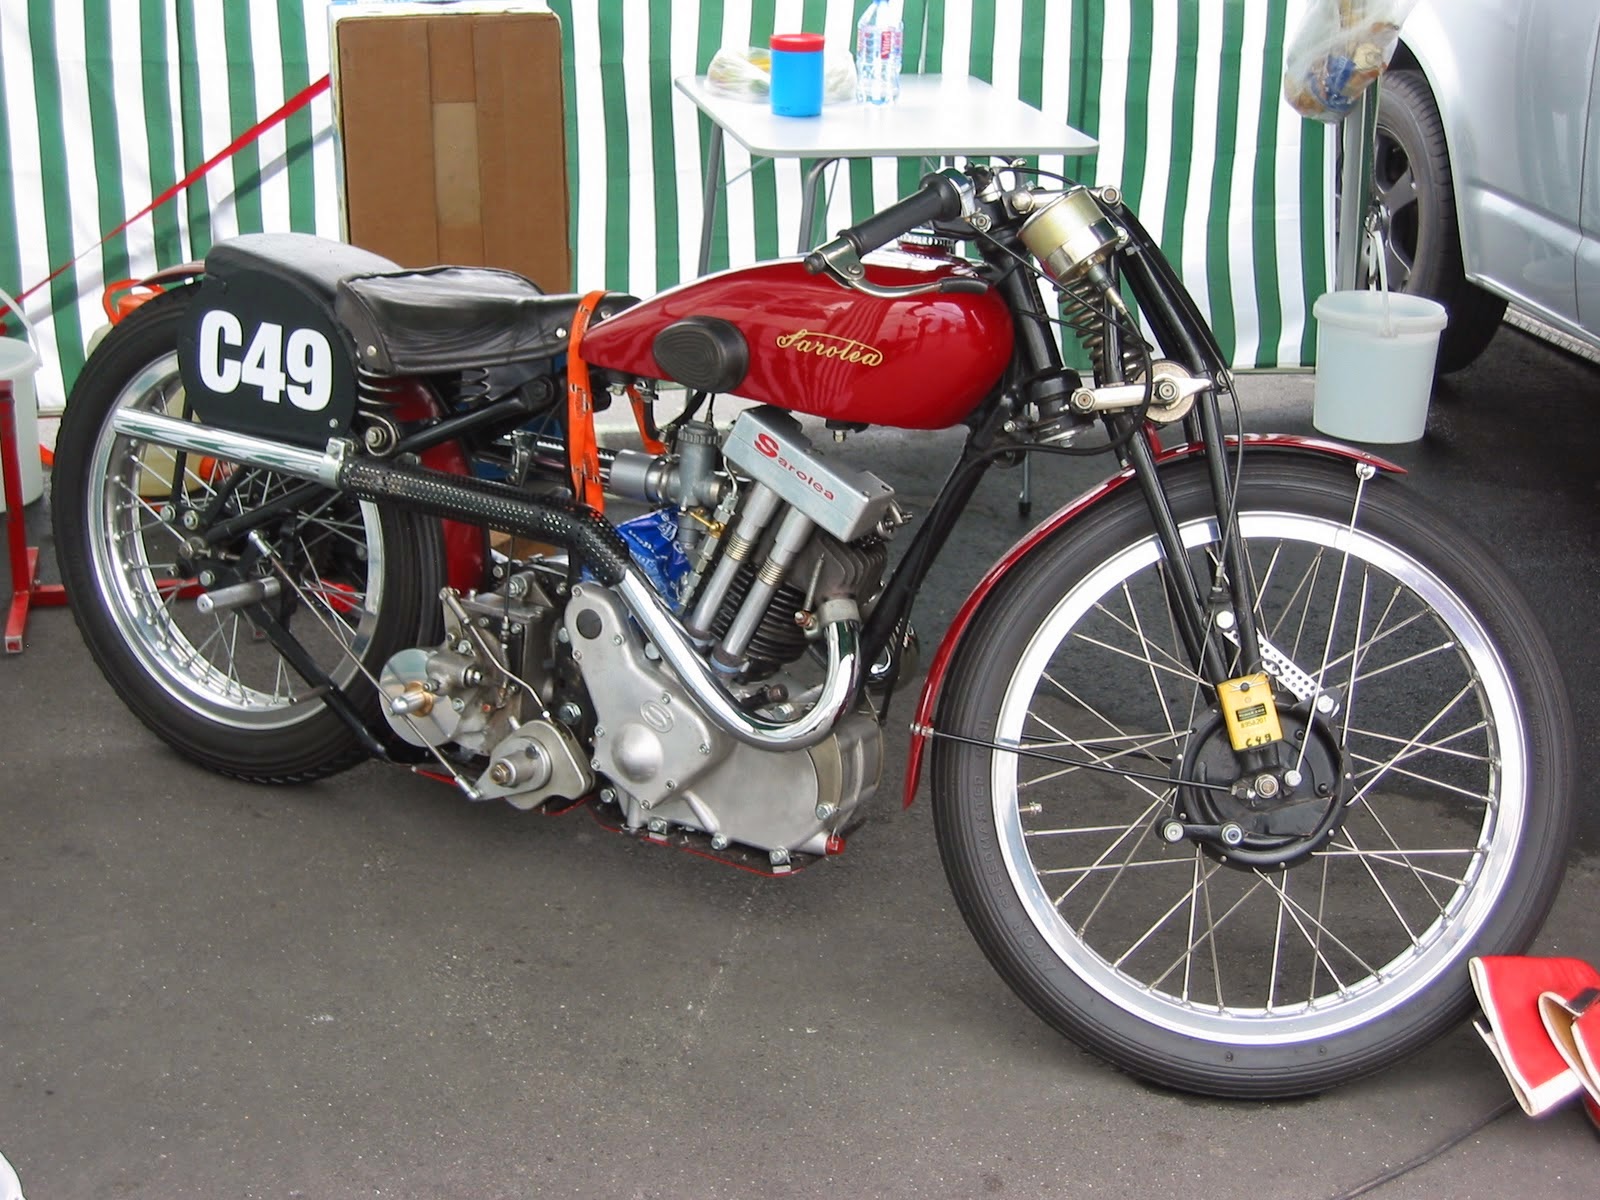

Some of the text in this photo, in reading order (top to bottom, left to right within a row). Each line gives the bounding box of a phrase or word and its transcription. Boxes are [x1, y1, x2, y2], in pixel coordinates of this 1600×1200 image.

[199, 309, 333, 411] C49
[754, 433, 835, 501] Sarolea
[974, 775, 1013, 910] SPEEDMASTER
[1011, 918, 1058, 973] AVON
